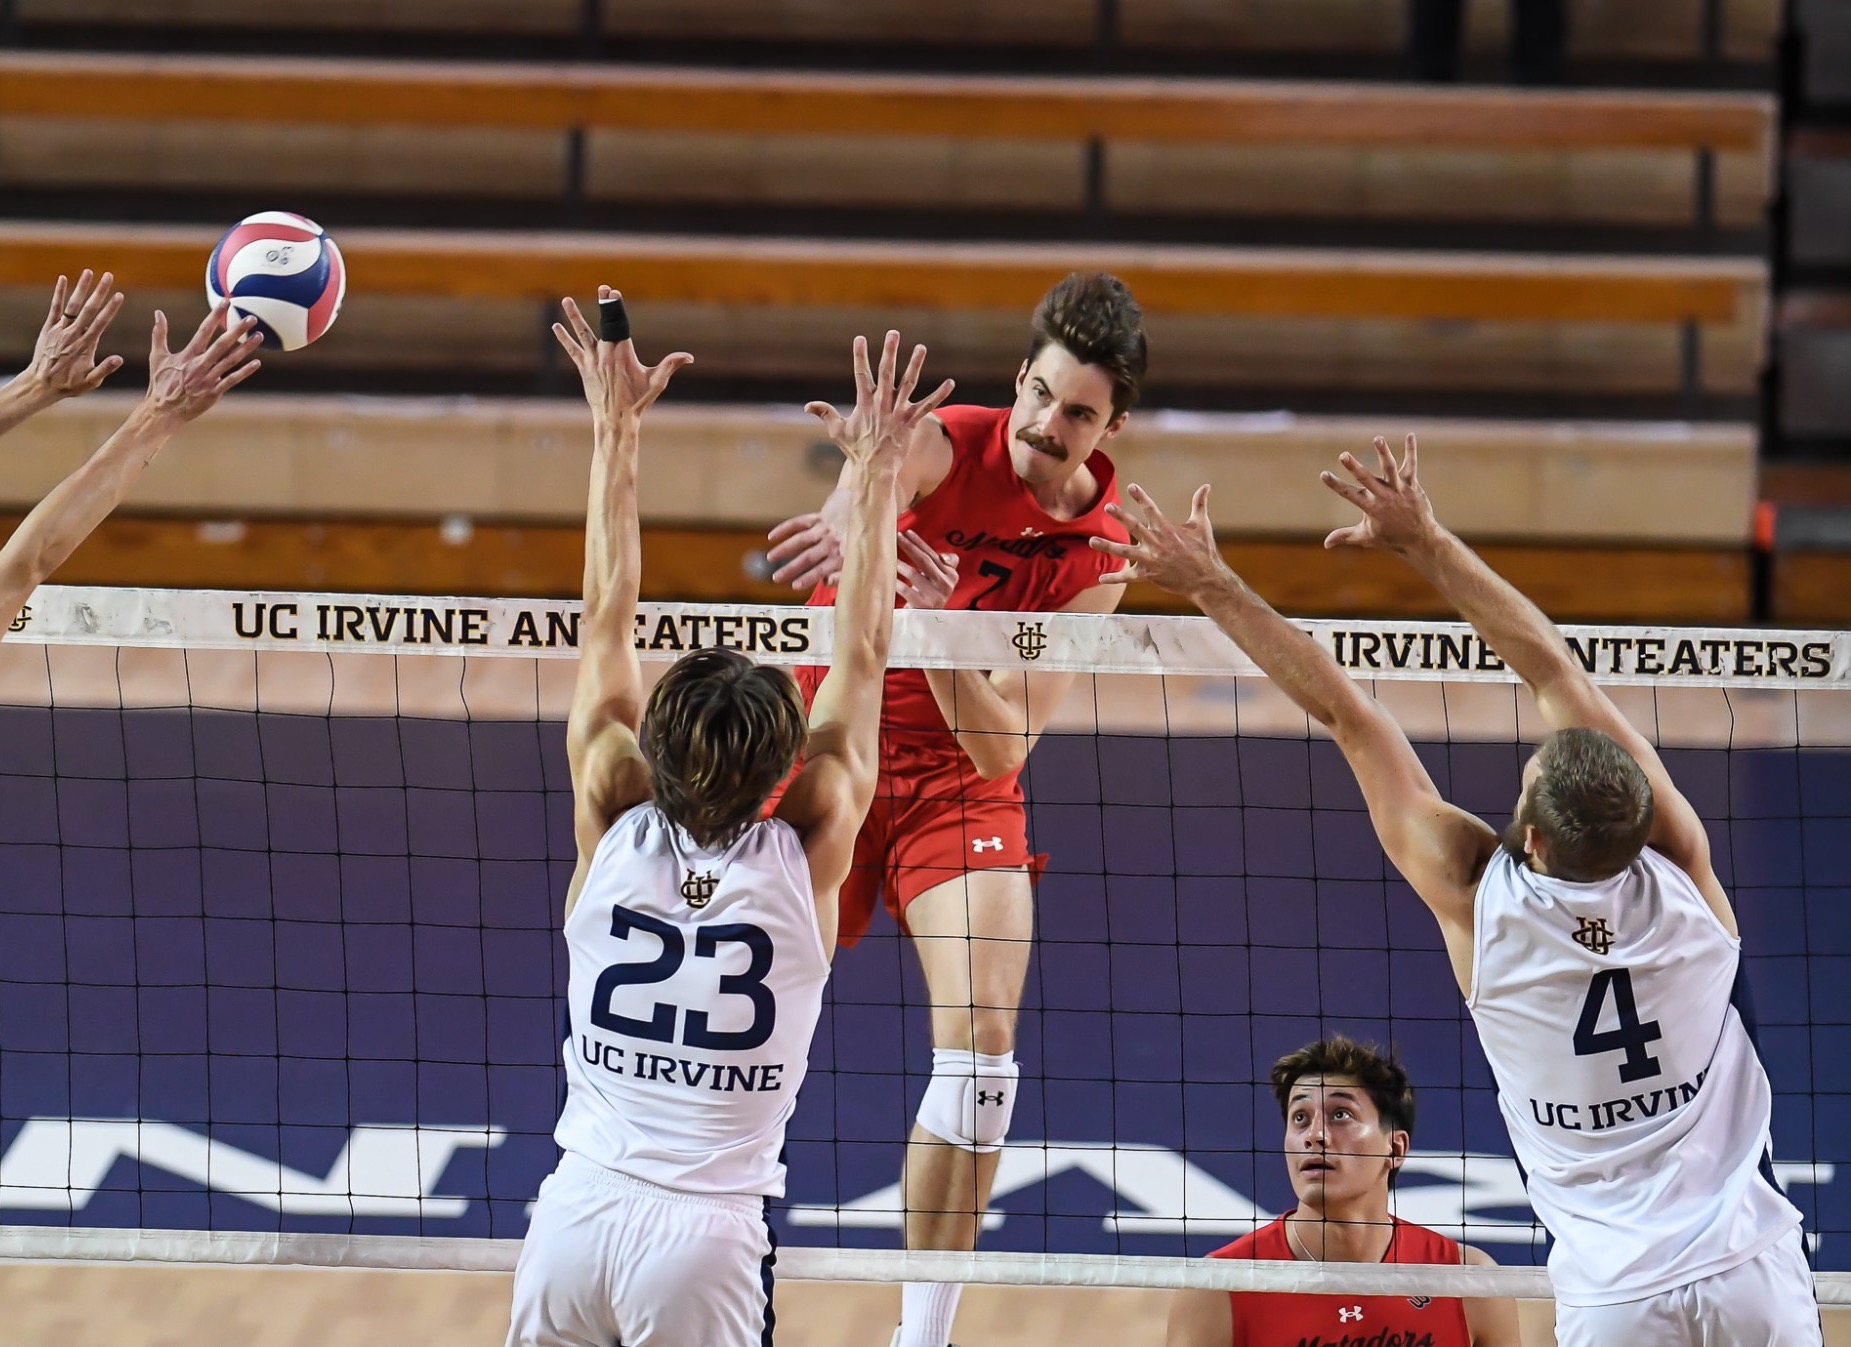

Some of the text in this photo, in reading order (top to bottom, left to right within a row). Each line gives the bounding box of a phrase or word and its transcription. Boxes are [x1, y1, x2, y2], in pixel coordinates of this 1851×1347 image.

[979, 559, 1012, 611] 7
[233, 602, 299, 641] UC
[316, 604, 488, 645] IRVINE
[1564, 637, 1832, 679] NTEATERS
[590, 903, 776, 1051] 23
[1573, 967, 1662, 1084] 4
[582, 1034, 784, 1092] UC IRVINE
[1529, 1065, 1711, 1130] UC IRVIN
